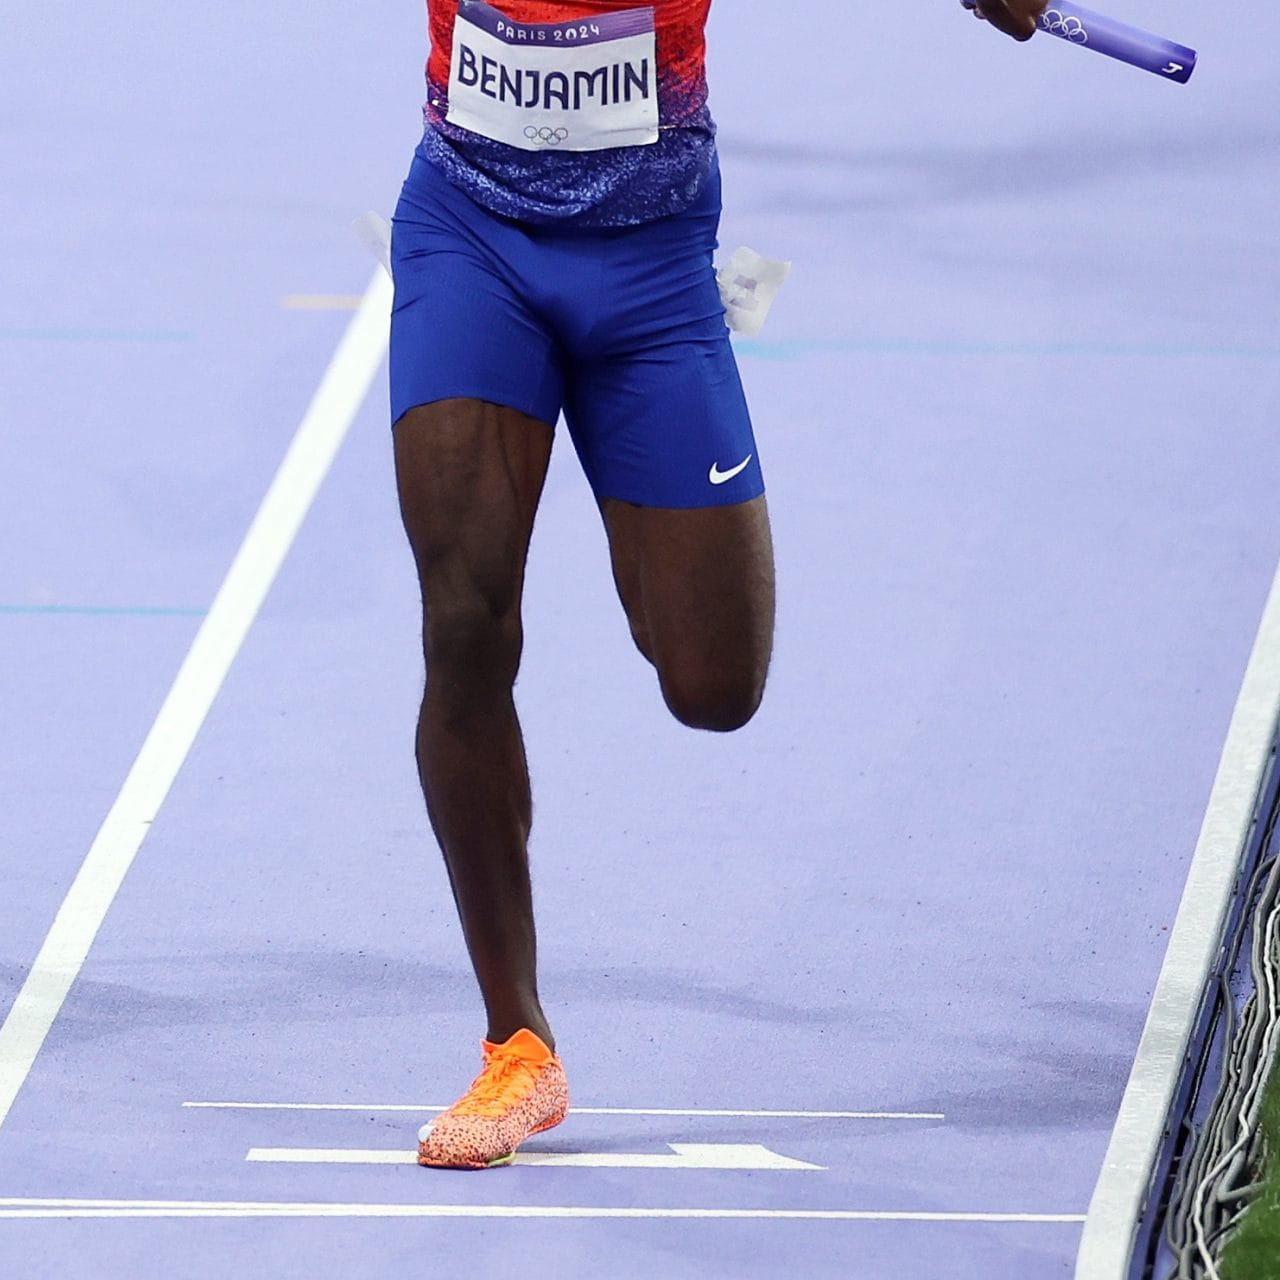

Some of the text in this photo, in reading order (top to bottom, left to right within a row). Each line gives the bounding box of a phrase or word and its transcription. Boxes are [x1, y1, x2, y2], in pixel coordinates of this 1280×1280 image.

[497, 20, 600, 41] PARIS 2024
[457, 43, 648, 111] BENJAMIN
